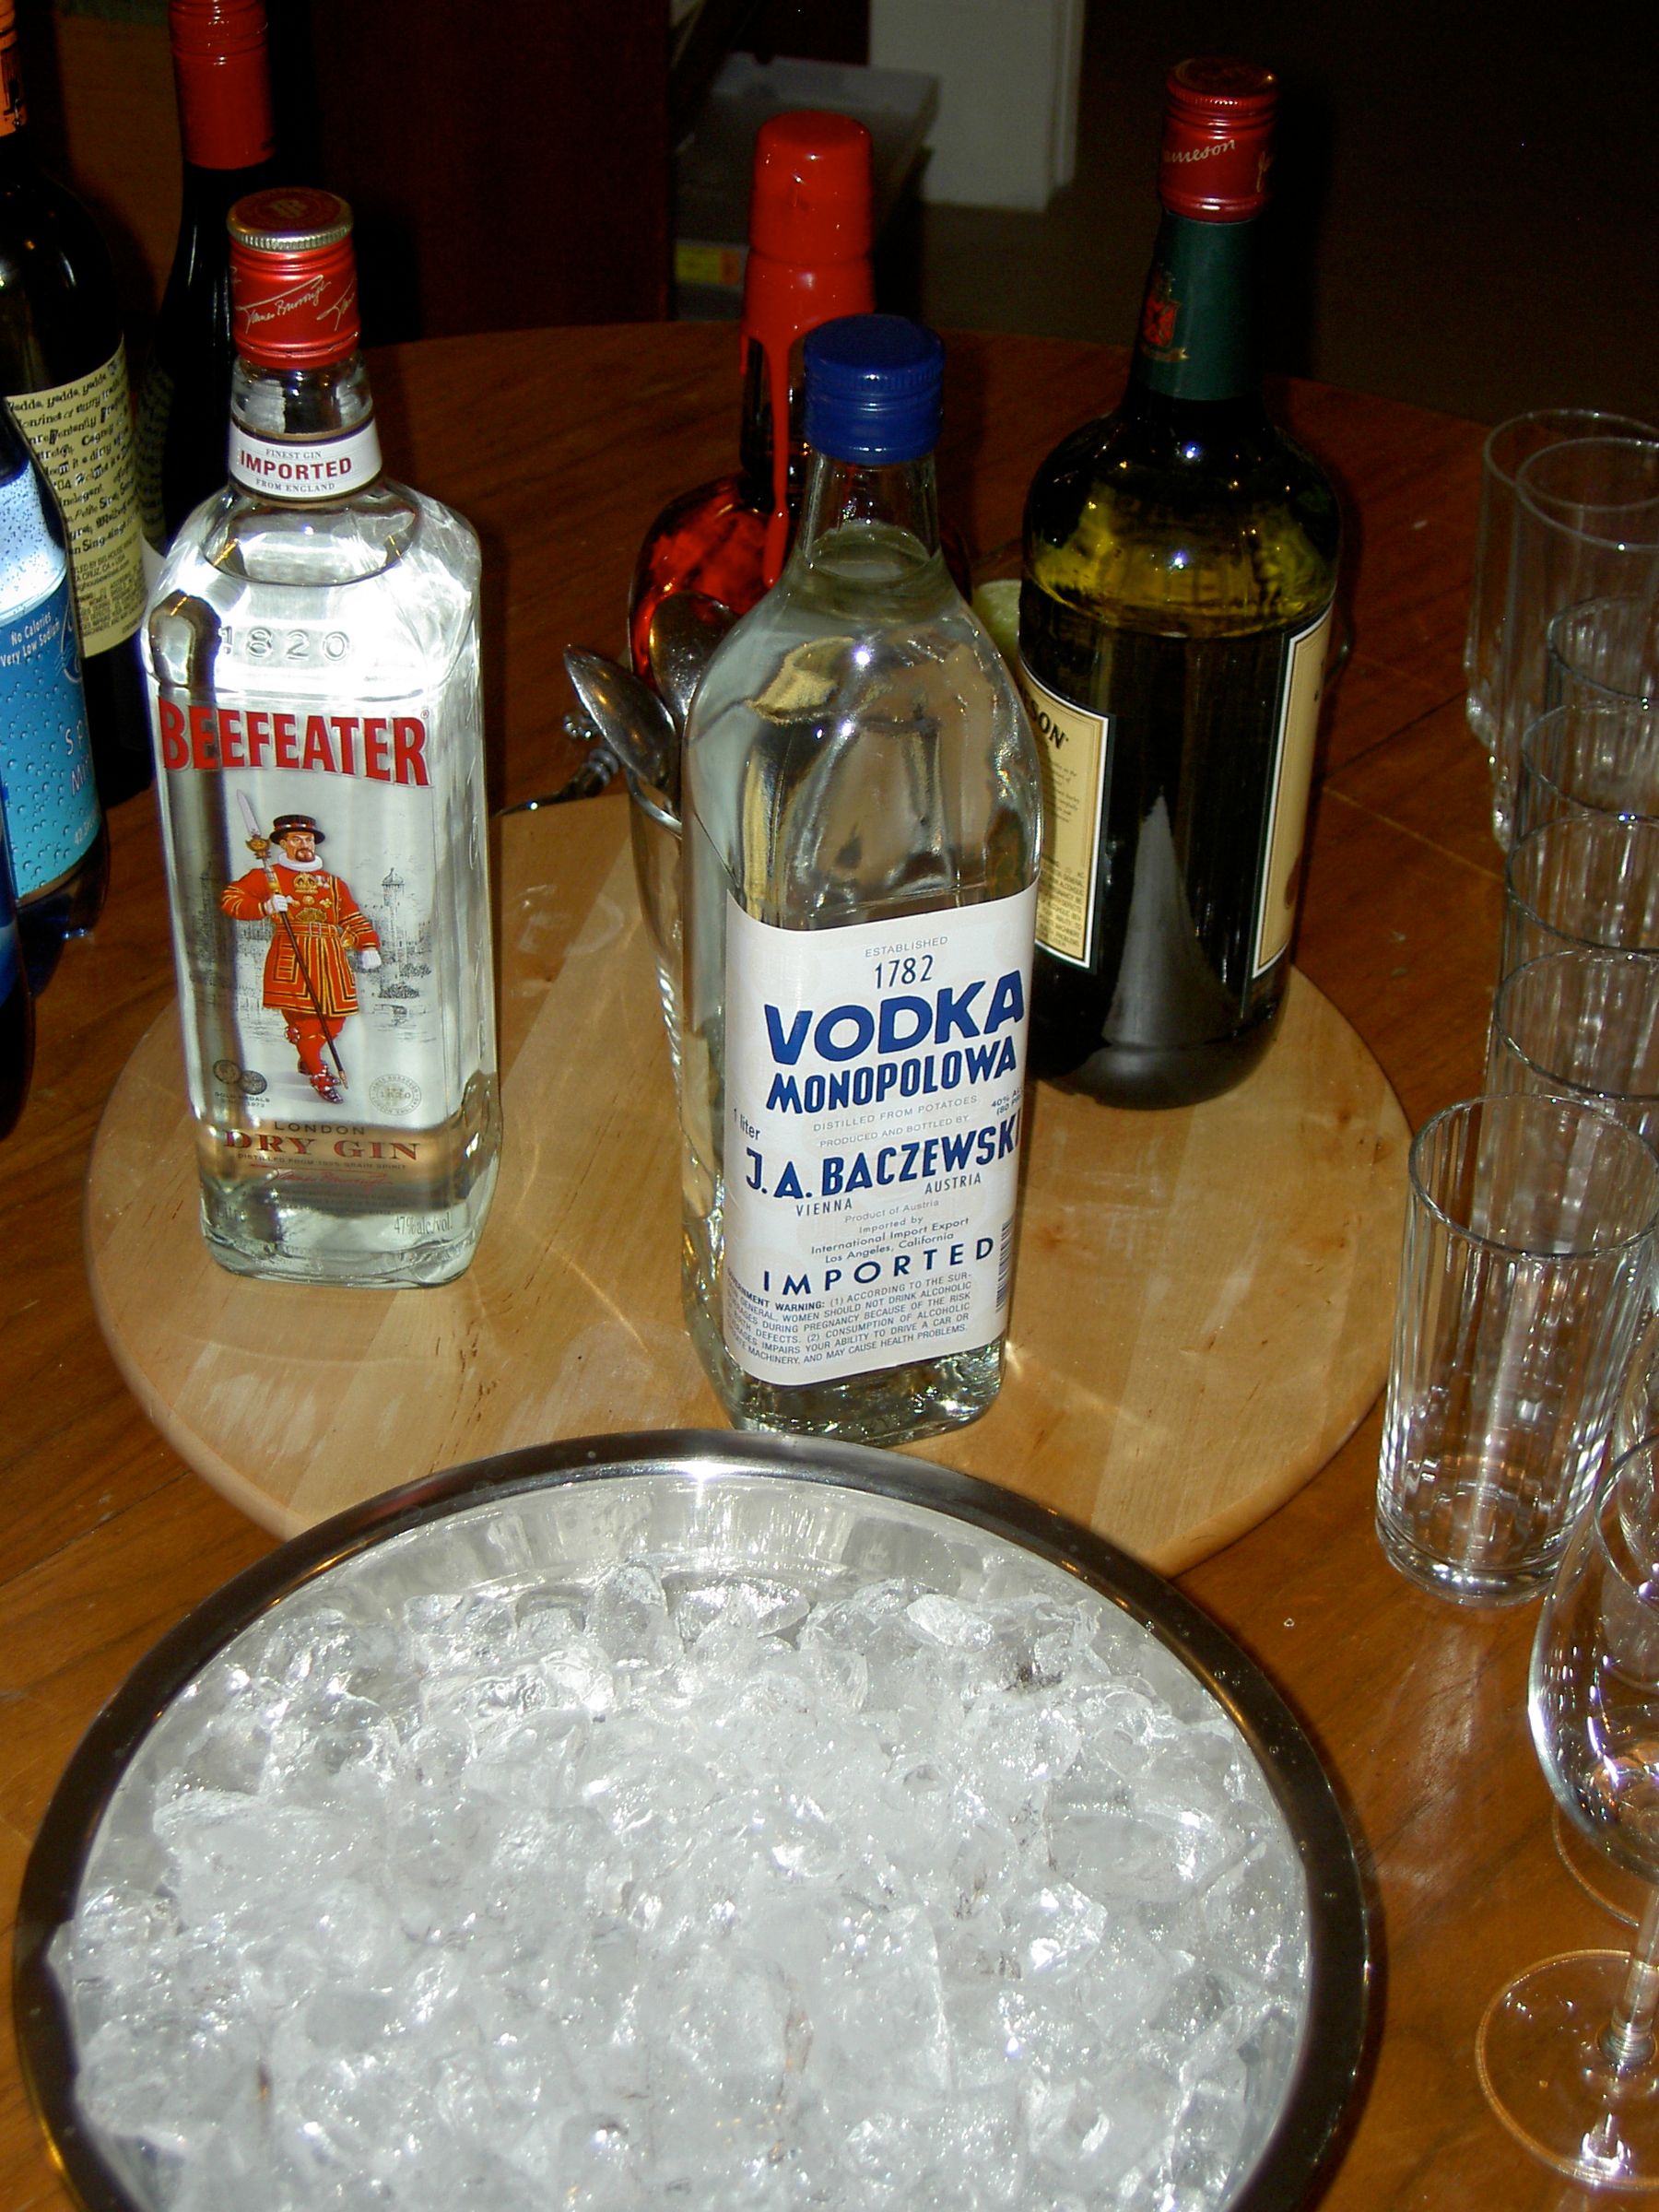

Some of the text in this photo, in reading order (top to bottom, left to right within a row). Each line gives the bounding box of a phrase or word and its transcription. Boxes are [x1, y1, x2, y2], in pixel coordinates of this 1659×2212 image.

[1163, 139, 1235, 162] ameson
[240, 450, 352, 480] IMPORTED
[265, 448, 322, 460] FINEST GIN
[256, 477, 335, 493] FROM ENGLAND
[11, 611, 52, 647] No Calories
[218, 625, 351, 661] 1820
[0, 651, 20, 667] Very
[23, 641, 38, 658] Low
[159, 696, 430, 787] BEEFEATER
[865, 935, 948, 959] ESTABLISHED
[875, 954, 934, 989] 1782
[764, 970, 1025, 1065] VODKA
[766, 1035, 1017, 1114] MONOPOLOWA
[275, 1121, 366, 1135] LONDON
[739, 1113, 761, 1140] liter
[813, 1095, 979, 1133] DISTILLED FROM POTATOES
[819, 1113, 971, 1148] PRODUCED AND BOTTLED BY
[224, 1130, 420, 1161] DRY GIN
[924, 1171, 982, 1195] AUSTRIA
[795, 1197, 853, 1218] VIENNA
[844, 1199, 940, 1224] Product of Austria
[859, 1214, 924, 1234] Imported by
[811, 1218, 970, 1255] International Import Export
[825, 1233, 955, 1264] Los Angeles, California
[763, 1237, 994, 1296] IMPORTED
[774, 1300, 826, 1312] WARNING:
[830, 1297, 843, 1308] (1)
[847, 1284, 905, 1302] ACCORDING
[909, 1280, 923, 1289] TO
[925, 1277, 945, 1288] THE
[947, 1273, 972, 1283] SUR-
[782, 1312, 820, 1323] WOMEN
[824, 1303, 861, 1318] SHOULD
[865, 1298, 885, 1310] NOT
[888, 1292, 917, 1304] DRINK
[920, 1280, 972, 1298] ALCOHOLIC
[755, 1328, 801, 1344] DEFECTS.
[807, 1333, 820, 1344] (2)
[826, 1316, 895, 1338] CONSUMPTION
[900, 1312, 913, 1323] OF
[917, 1301, 971, 1319] ALCOHOLIC
[762, 1320, 799, 1334] DURING
[804, 1314, 860, 1333] PREGNANCY
[864, 1304, 906, 1320] BECAUSE
[911, 1301, 923, 1311] OF
[927, 1296, 945, 1307] THE
[949, 1291, 971, 1303] RISK
[761, 1312, 970, 1355] IMPAIRS YOUR ABILITY TO DRIVE A CAR OR
[804, 1353, 823, 1364] AND
[826, 1348, 845, 1359] MAY
[848, 1341, 877, 1355] CAUSE
[880, 1335, 915, 1348] HEALTH
[917, 1323, 969, 1340] PROBLEMS.
